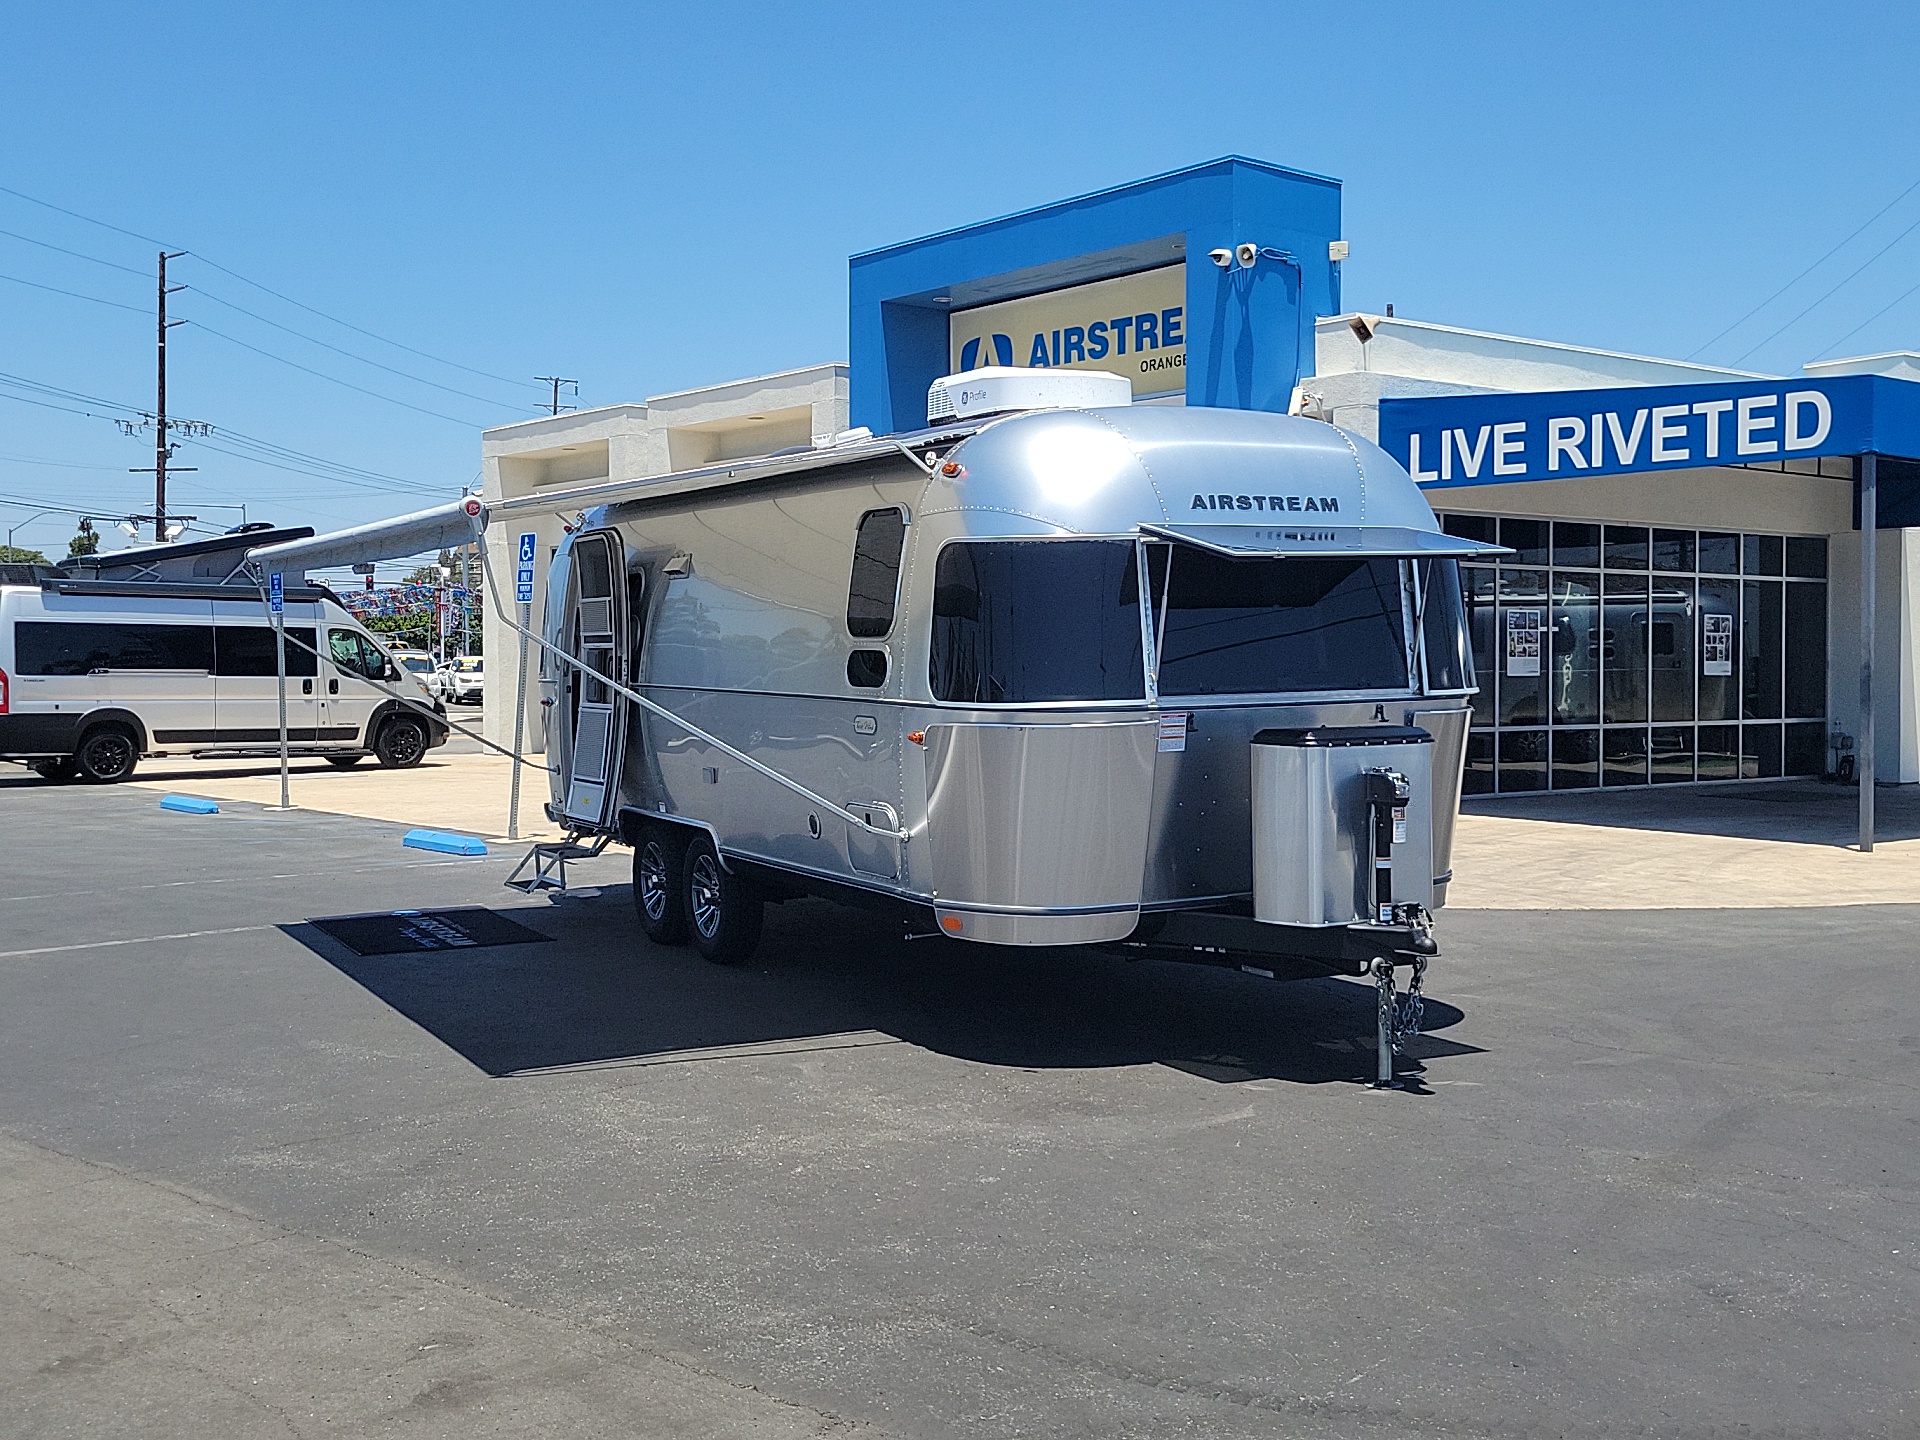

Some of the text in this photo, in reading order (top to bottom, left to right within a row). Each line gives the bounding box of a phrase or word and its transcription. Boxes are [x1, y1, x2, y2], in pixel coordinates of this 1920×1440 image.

[1028, 306, 1186, 369] AIRSTRE
[1409, 389, 1833, 482] LIVE RIVETED
[1190, 494, 1340, 513] AIRSTREAM
